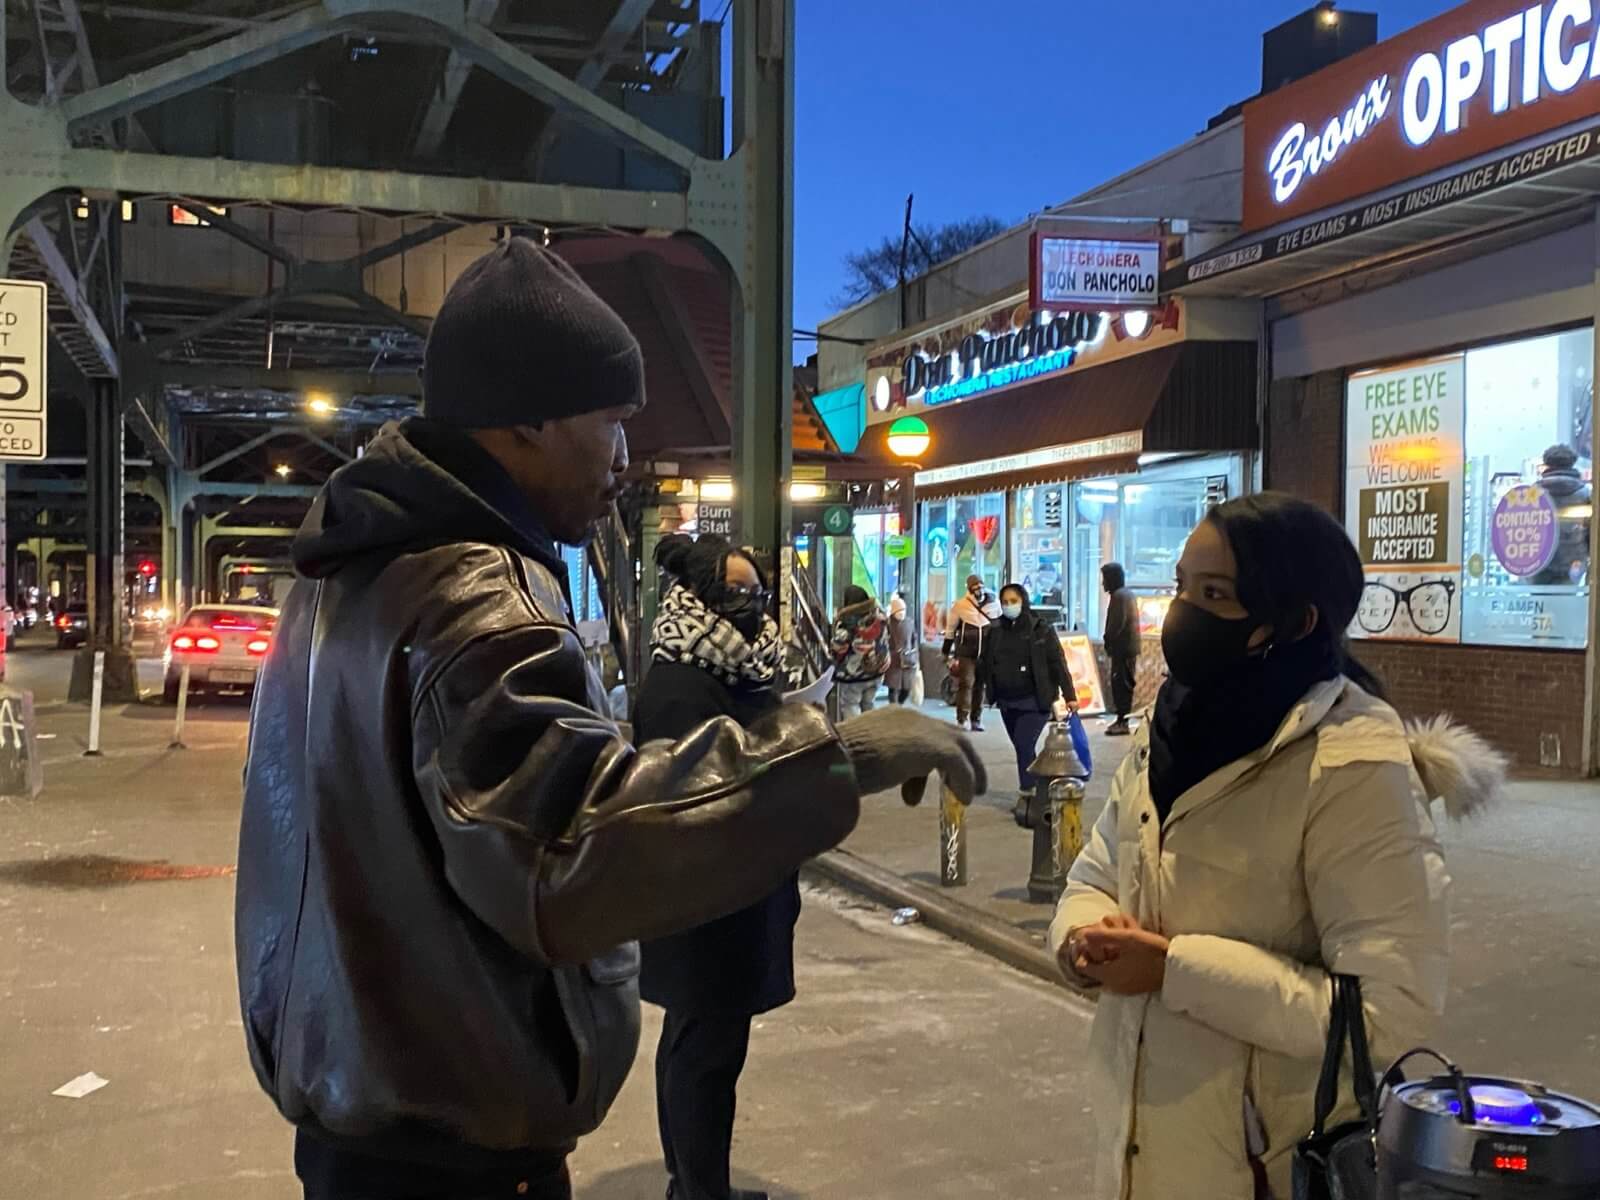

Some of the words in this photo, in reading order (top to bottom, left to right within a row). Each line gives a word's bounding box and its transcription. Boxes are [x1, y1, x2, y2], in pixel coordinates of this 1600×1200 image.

[1268, 74, 1392, 203] Bronx
[1402, 0, 1600, 146] OPTIC
[1276, 235, 1300, 254] EYE
[1301, 215, 1347, 245] EXAMS
[1361, 198, 1403, 227] MOST
[1404, 164, 1495, 213] INSURANCE
[1495, 132, 1592, 182] ACCEPTED
[1061, 250, 1141, 269] LECHONERA
[1047, 271, 1077, 291] DON
[1083, 271, 1156, 293] PANCHOLO
[902, 354, 953, 397] Don
[1365, 378, 1408, 411] FREE
[1412, 371, 1447, 402] EYE
[1371, 405, 1440, 440] EXAMS
[1367, 462, 1442, 485] WELCOME
[1375, 487, 1429, 514] MOST
[829, 511, 842, 527] 4
[1367, 513, 1438, 539] INSURANCE
[1496, 509, 1551, 528] CONTACTS
[1505, 527, 1541, 543] 10%
[1372, 537, 1435, 561] ACCEPTED
[1505, 543, 1541, 560] OFF
